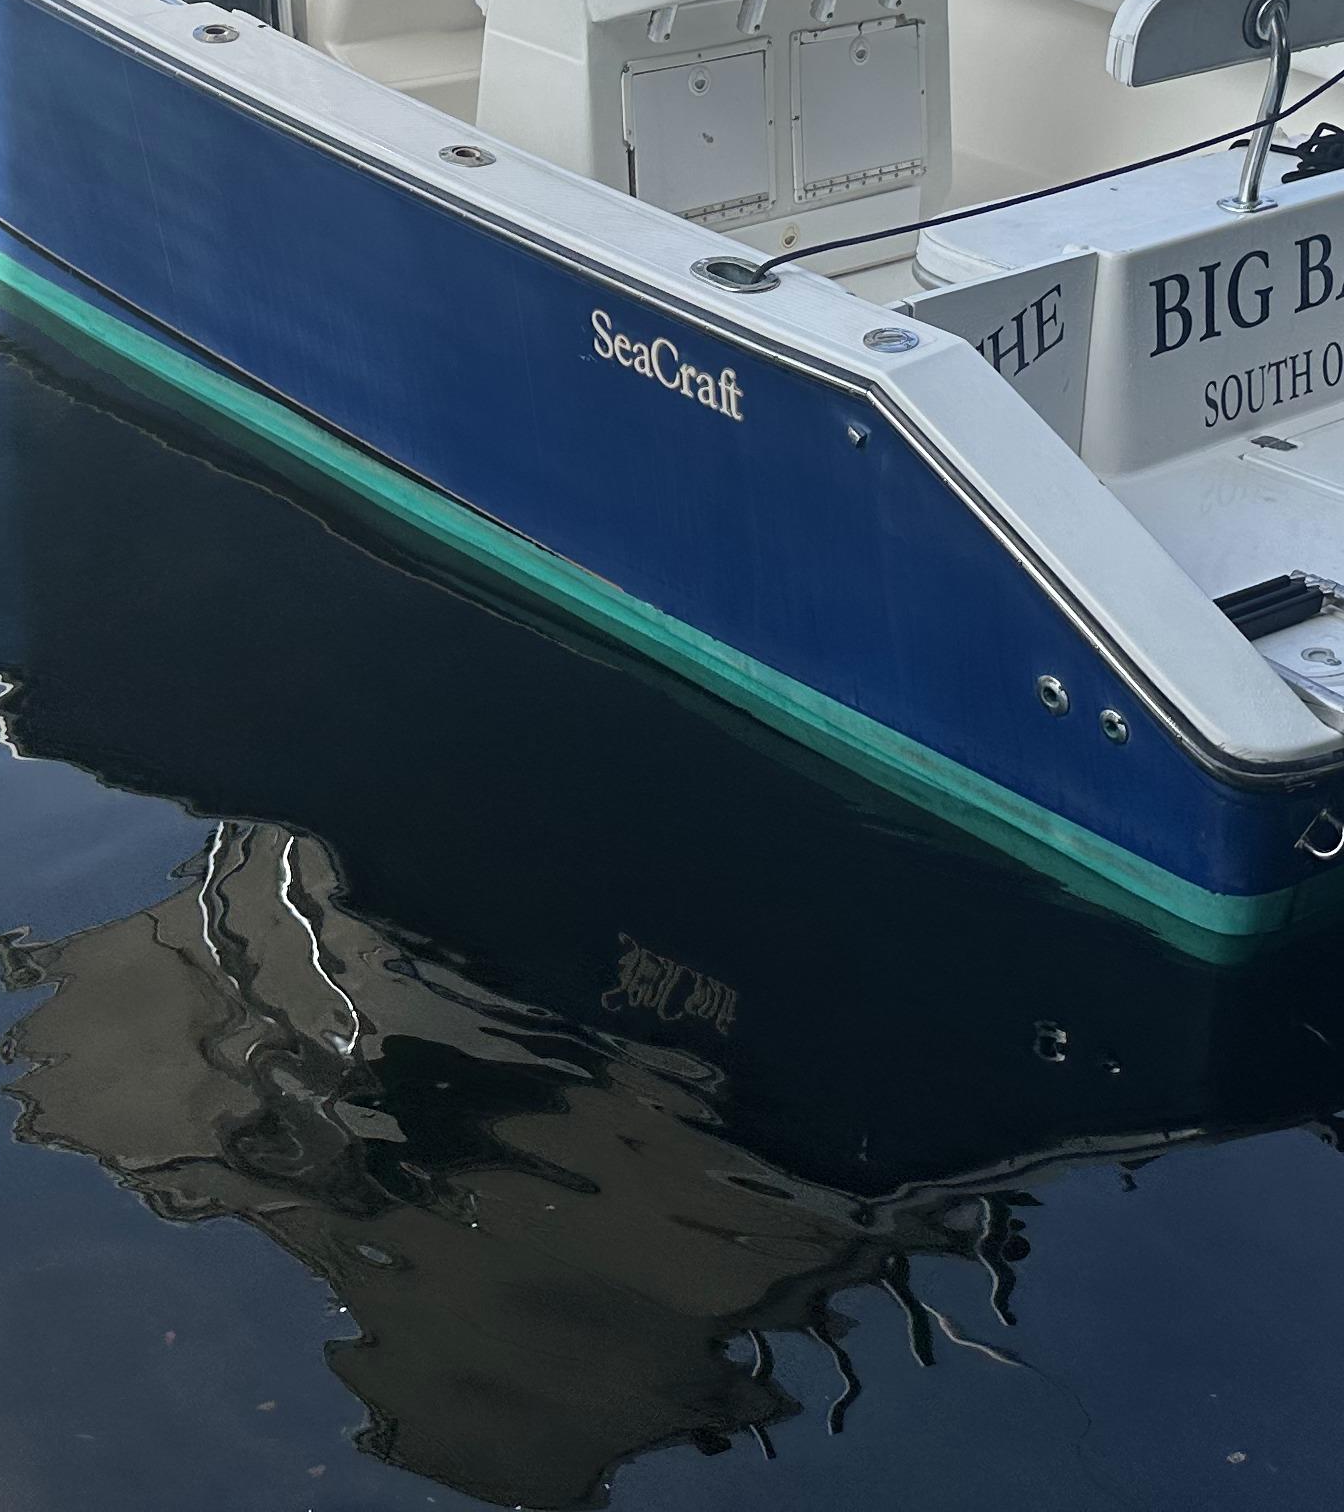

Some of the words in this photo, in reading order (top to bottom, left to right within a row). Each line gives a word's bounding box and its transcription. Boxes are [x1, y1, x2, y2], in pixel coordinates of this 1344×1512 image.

[1149, 250, 1274, 358] BIG
[591, 309, 744, 422] SeaCraft
[1204, 349, 1314, 428] SOUTH
